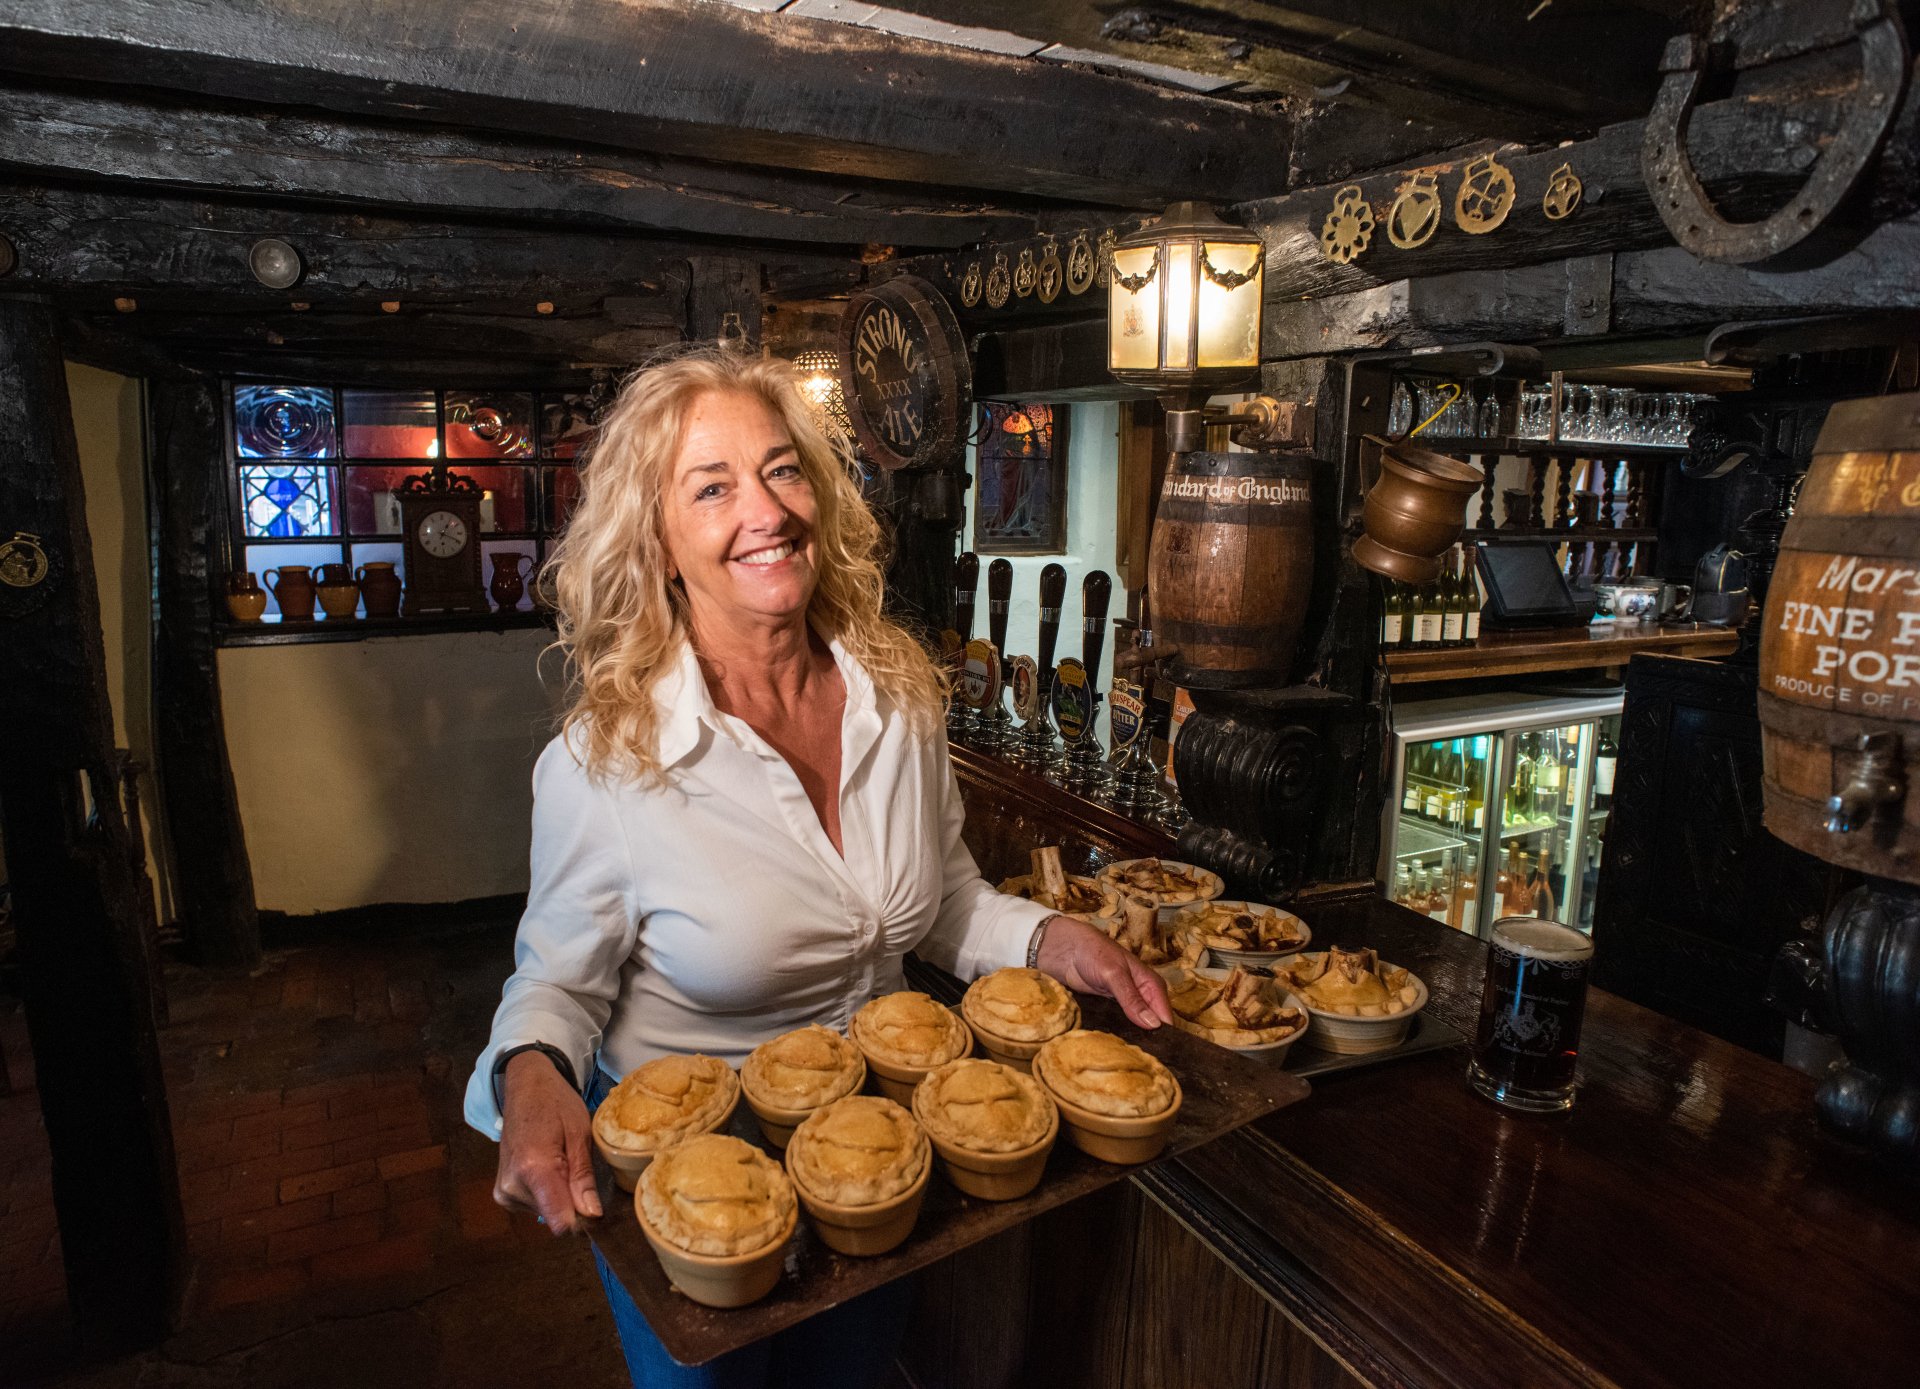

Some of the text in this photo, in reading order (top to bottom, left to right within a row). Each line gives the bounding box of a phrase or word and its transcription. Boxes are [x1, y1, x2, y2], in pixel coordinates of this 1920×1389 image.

[880, 401, 922, 446] ALE
[1223, 486, 1237, 500] of
[1238, 476, 1311, 505] England
[1780, 602, 1875, 641] FINE
[1775, 674, 1853, 702] PRODUCE
[1862, 691, 1894, 707] OF
